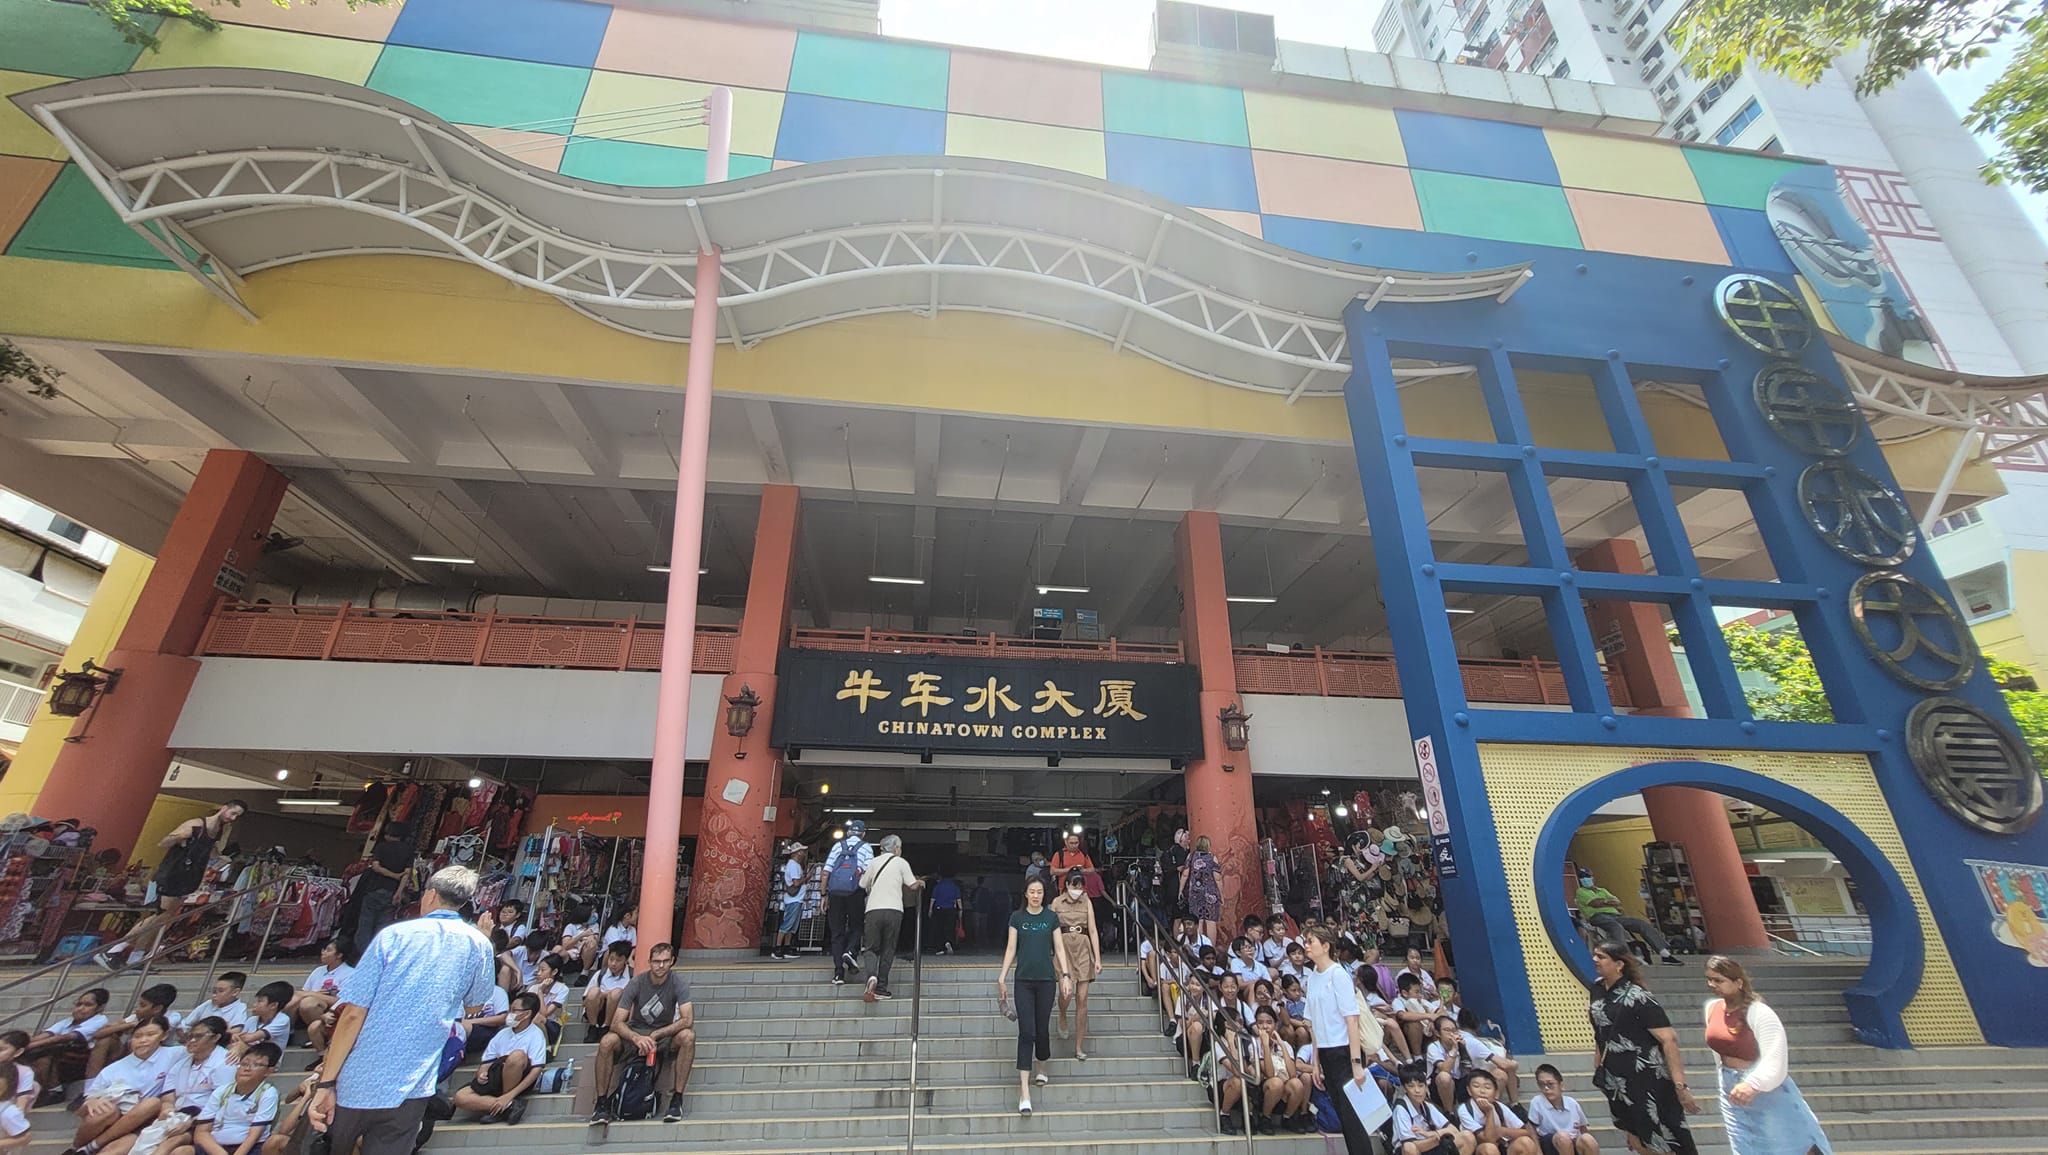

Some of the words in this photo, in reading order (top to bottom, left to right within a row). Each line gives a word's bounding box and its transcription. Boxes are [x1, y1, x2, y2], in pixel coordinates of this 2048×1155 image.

[836, 669, 1148, 721] 牛车水大厦
[878, 720, 1004, 738] CHINATOWN
[1012, 725, 1107, 740] COMPLEX
